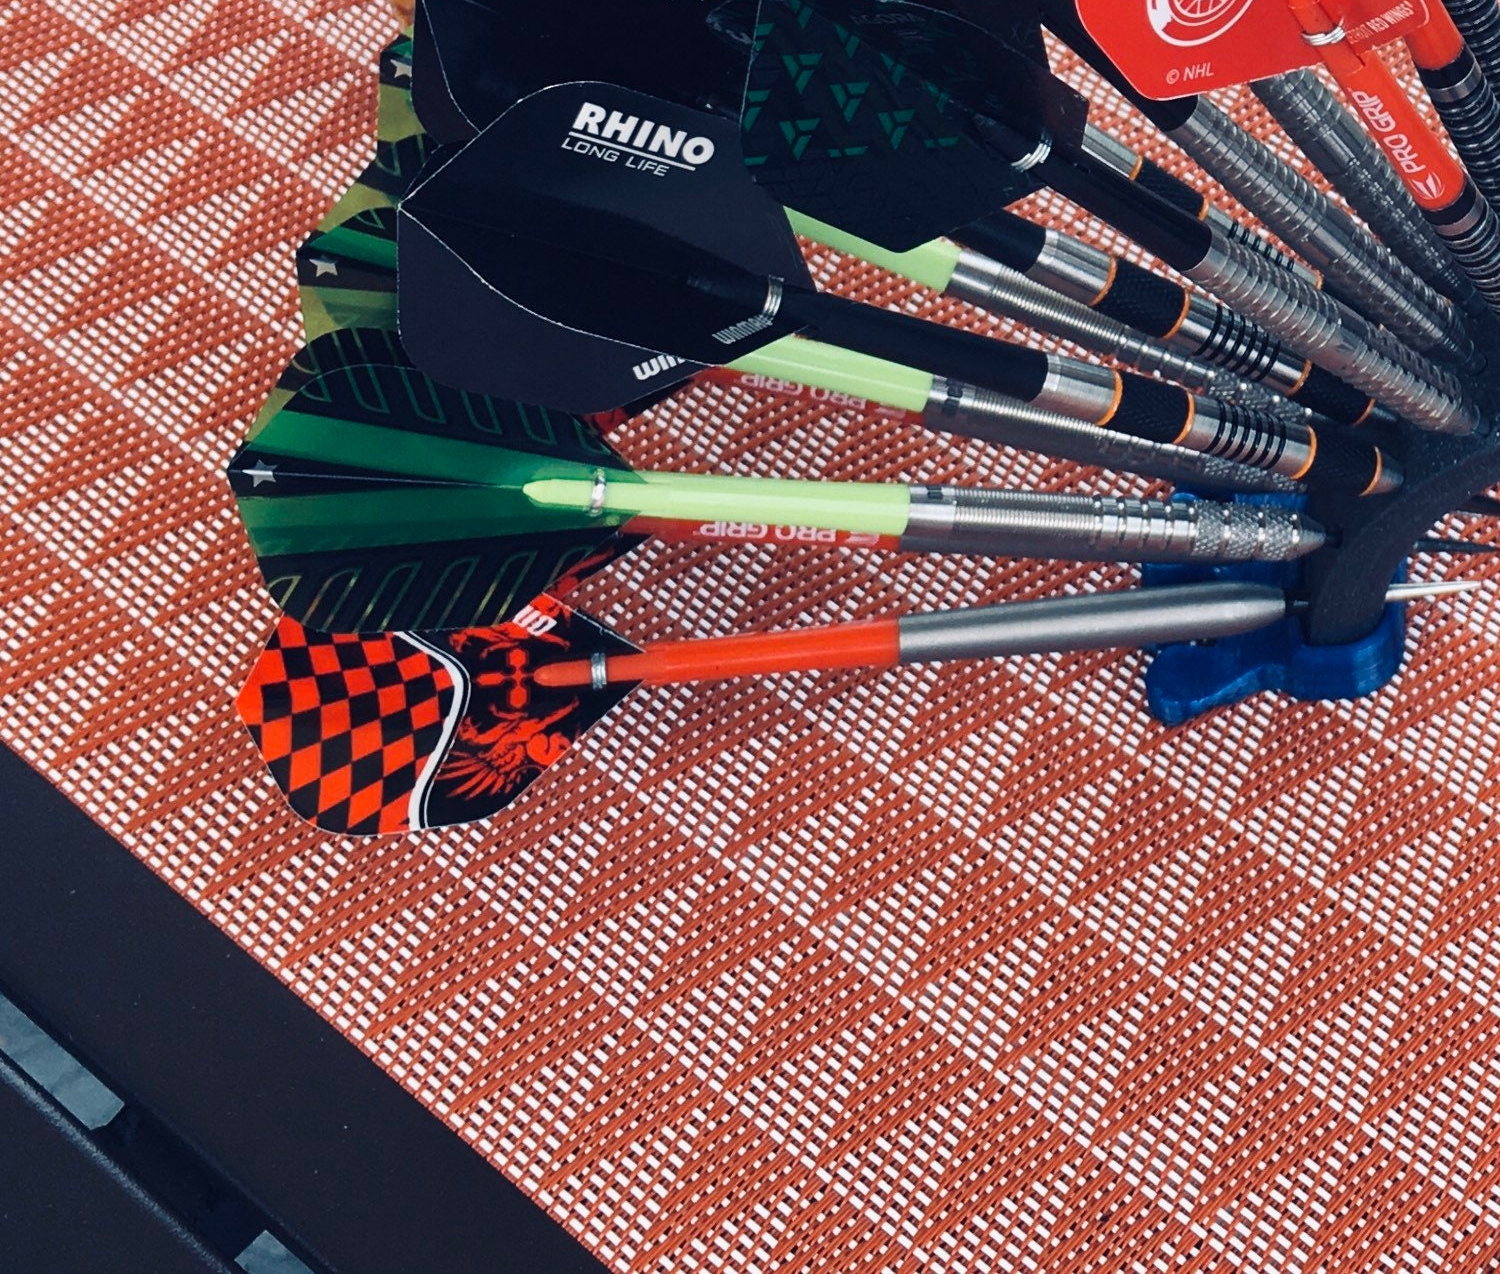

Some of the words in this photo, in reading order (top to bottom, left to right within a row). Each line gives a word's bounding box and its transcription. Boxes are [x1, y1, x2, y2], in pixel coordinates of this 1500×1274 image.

[1366, 16, 1390, 33] RED
[1183, 61, 1214, 82] NHL
[1351, 90, 1396, 133] GRIP
[572, 101, 715, 165] RHINO
[561, 137, 621, 162] LONG
[625, 155, 670, 177] LIFE
[1383, 133, 1427, 174] PRO
[700, 520, 768, 539] GRIP
[774, 524, 837, 542] PRO
